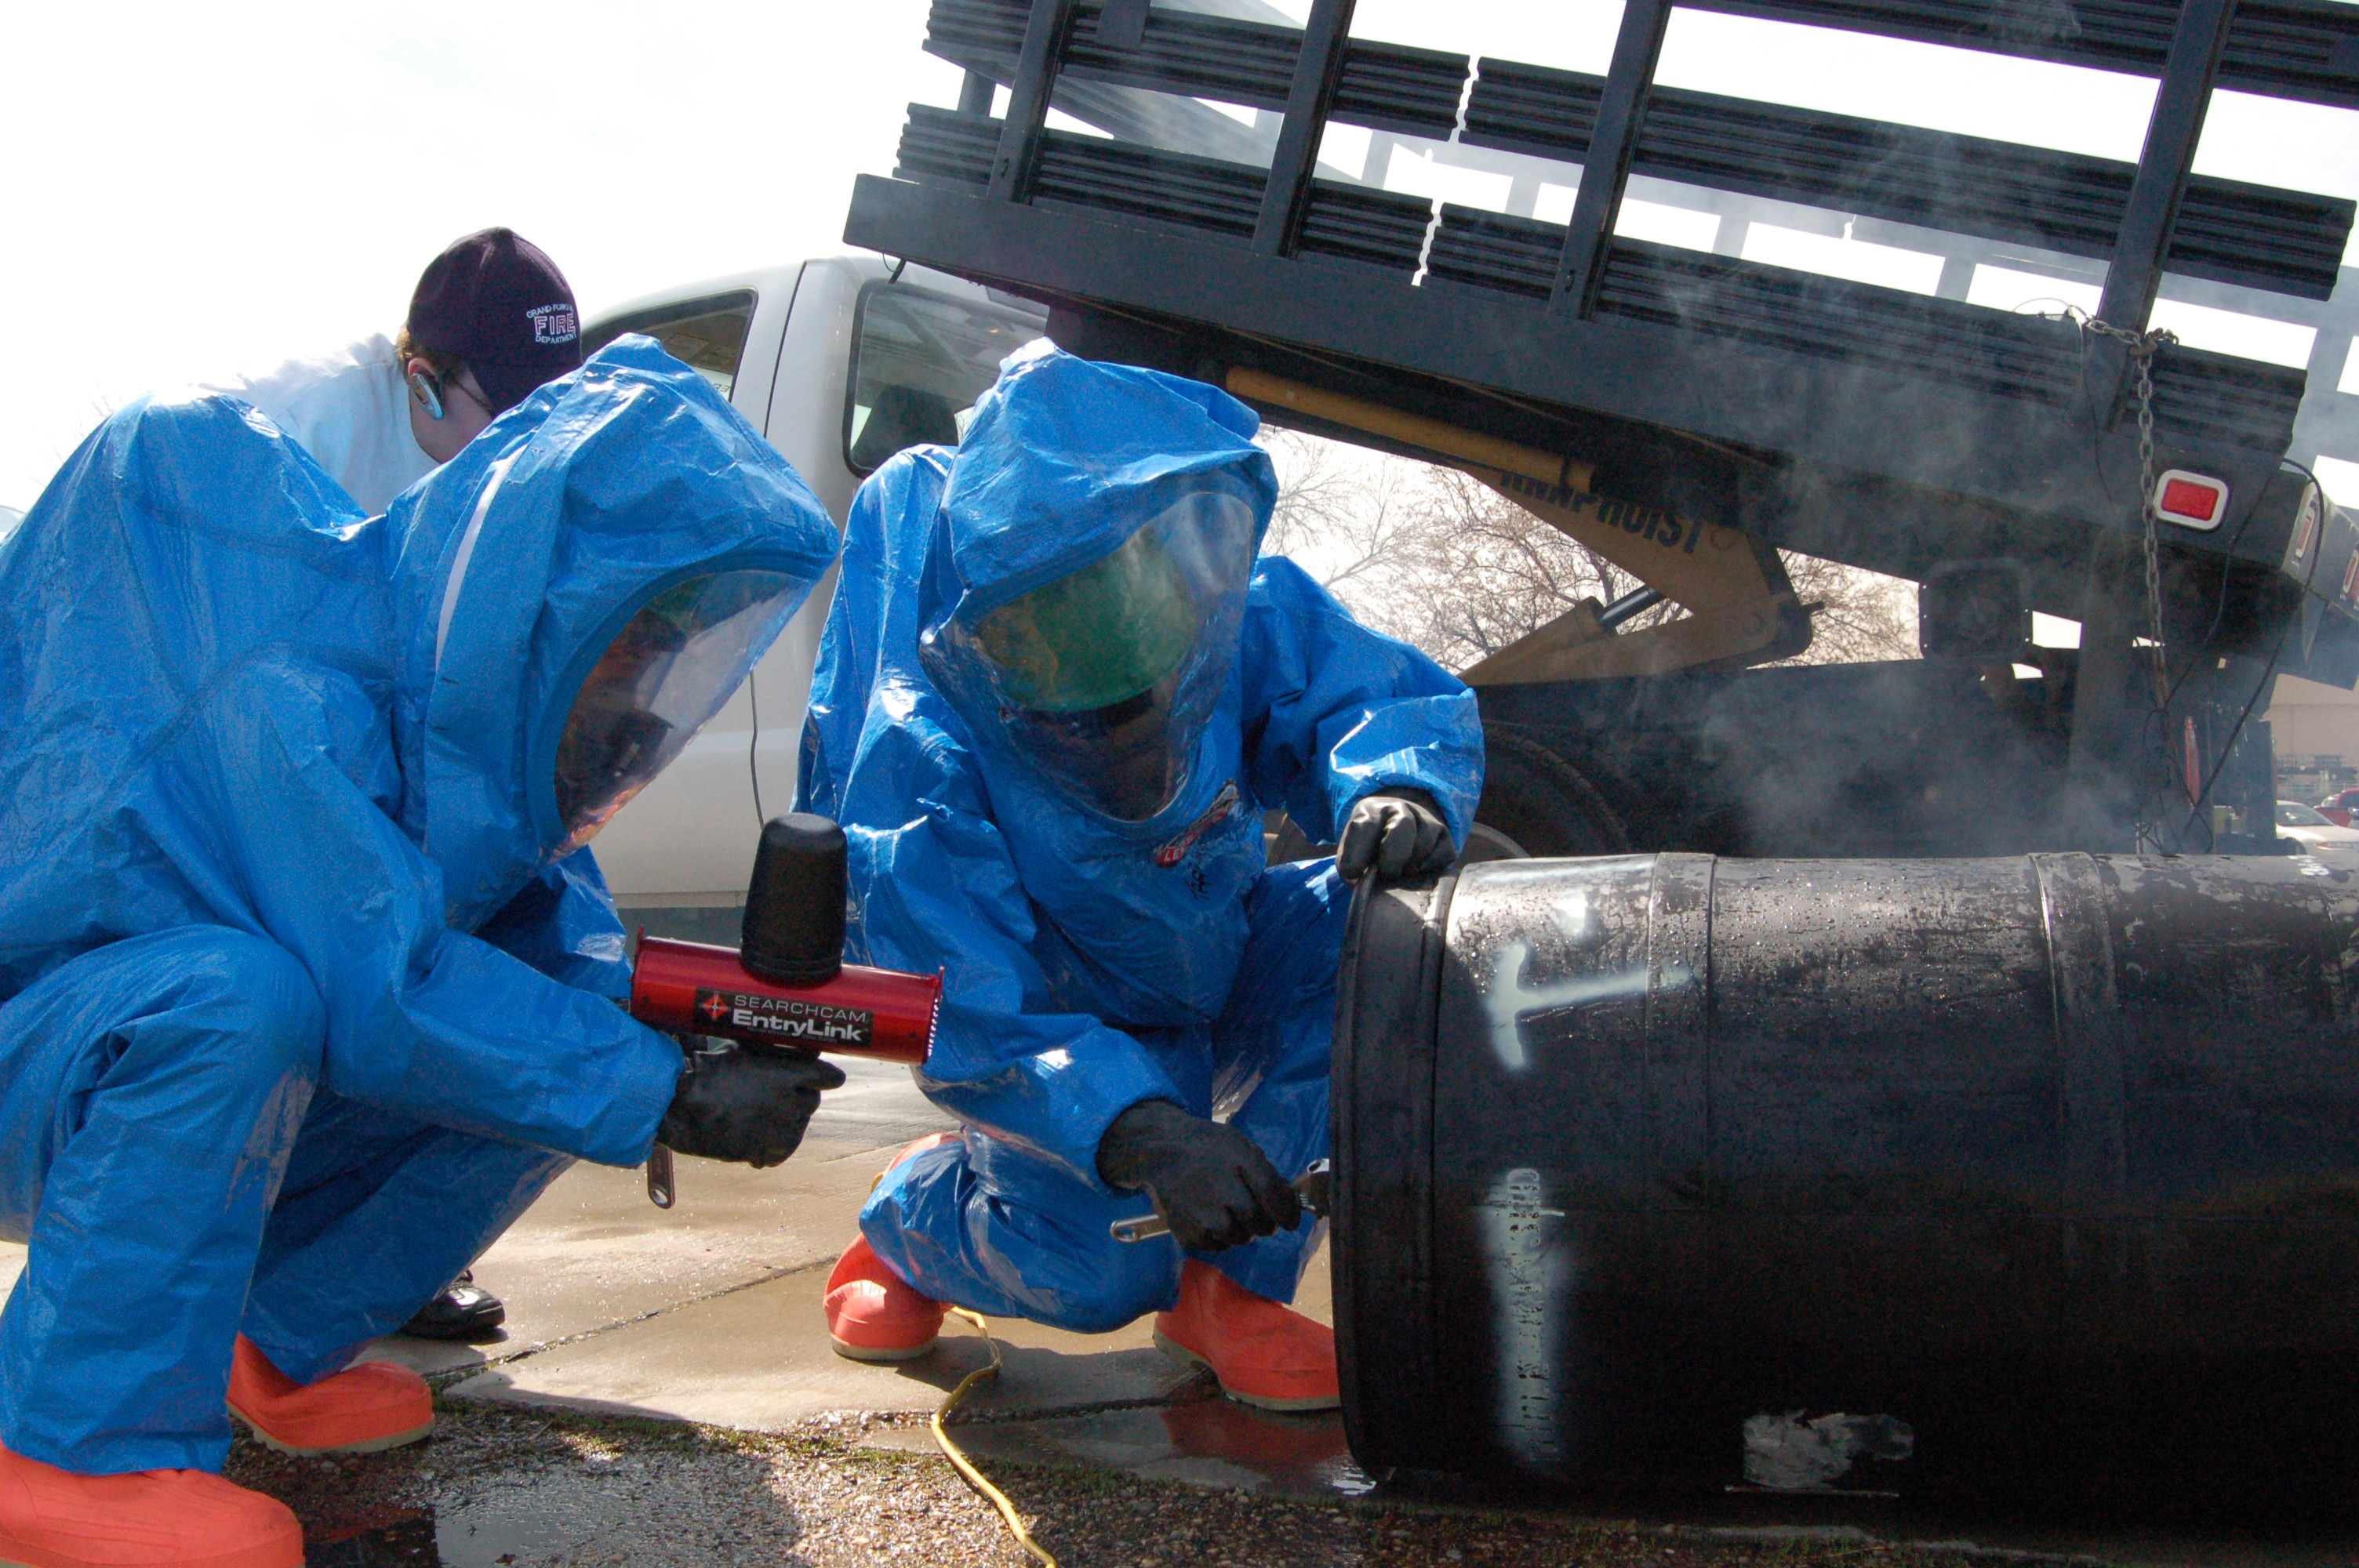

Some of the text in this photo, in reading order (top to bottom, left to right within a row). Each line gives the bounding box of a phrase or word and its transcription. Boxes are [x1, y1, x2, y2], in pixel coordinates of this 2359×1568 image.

[526, 305, 552, 318] GRAND
[534, 313, 576, 335] FIRE
[536, 332, 576, 344] DEPARTMENT
[735, 995, 866, 1022] SEARCHCAM
[732, 1008, 863, 1041] EntryLink
